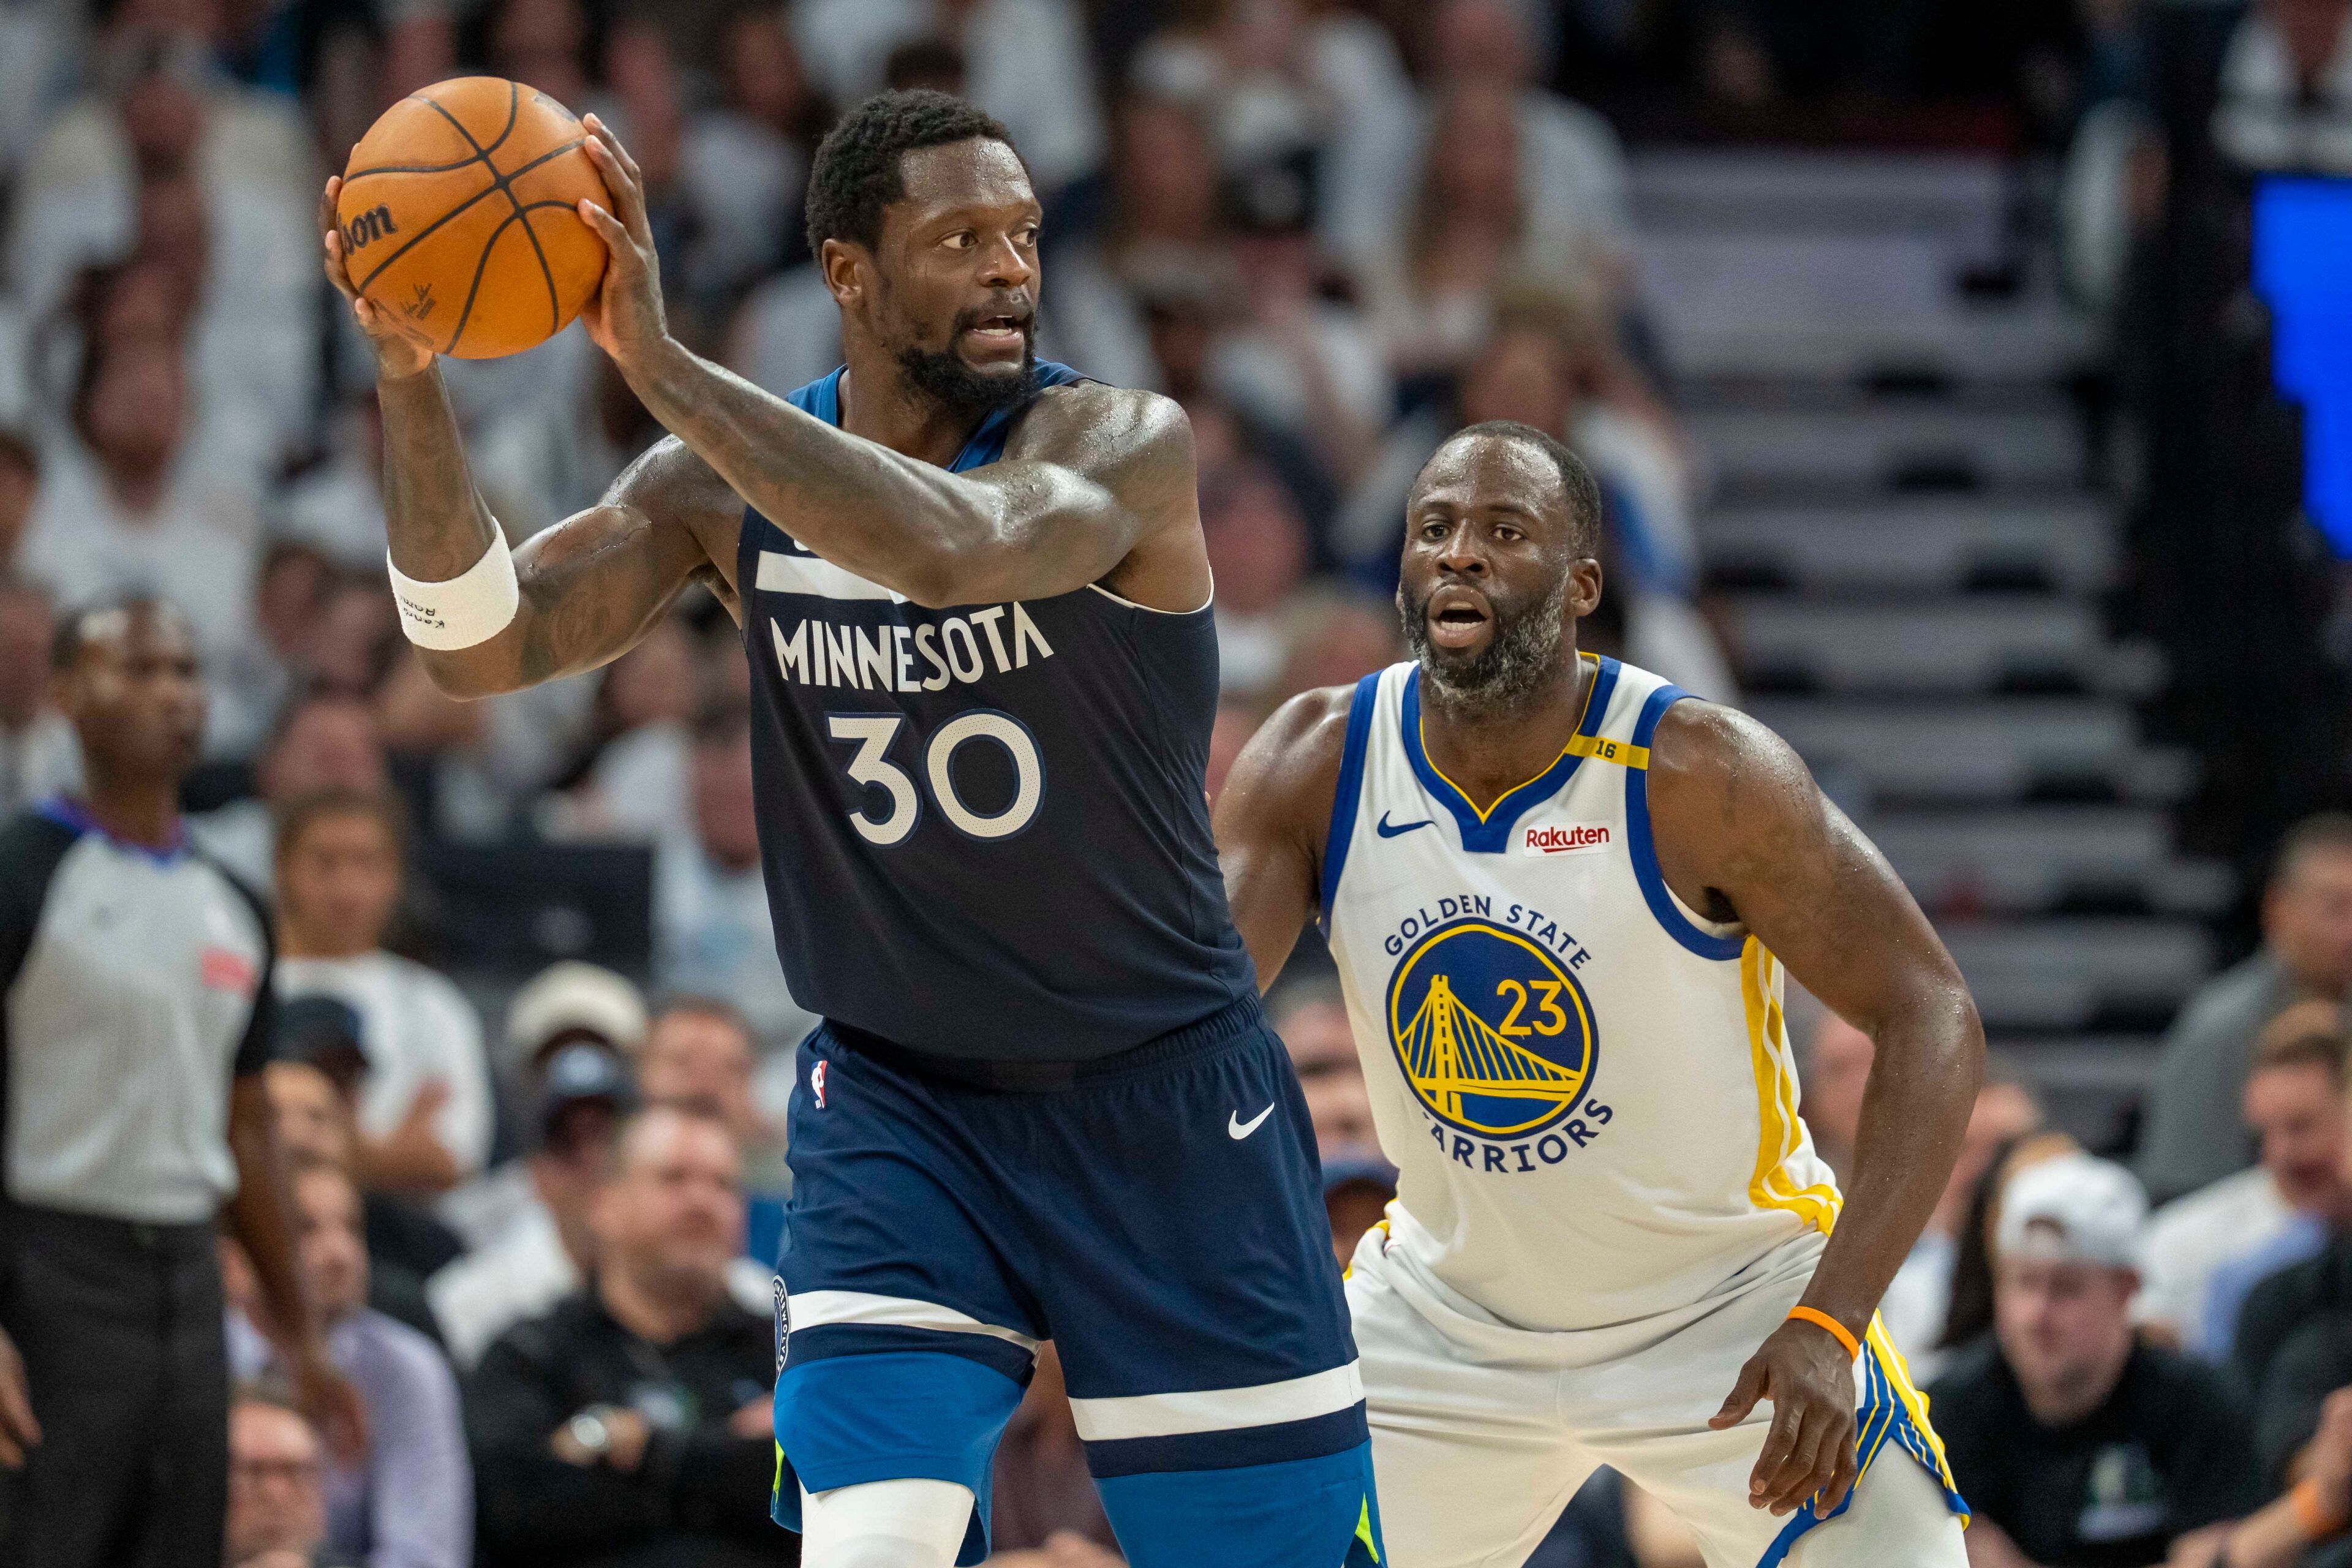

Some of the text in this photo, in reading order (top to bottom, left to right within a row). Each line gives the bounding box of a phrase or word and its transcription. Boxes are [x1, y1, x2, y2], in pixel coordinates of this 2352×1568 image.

[337, 204, 398, 255] son
[770, 601, 1054, 692] MINNESOTA
[828, 713, 1041, 845] 30
[1596, 740, 1616, 759] 16
[1526, 826, 1610, 848] Rakuten
[1384, 894, 1592, 970] GOLDEN STATE
[1496, 979, 1567, 1036] 23
[1423, 1098, 1613, 1173] ARRIORS
